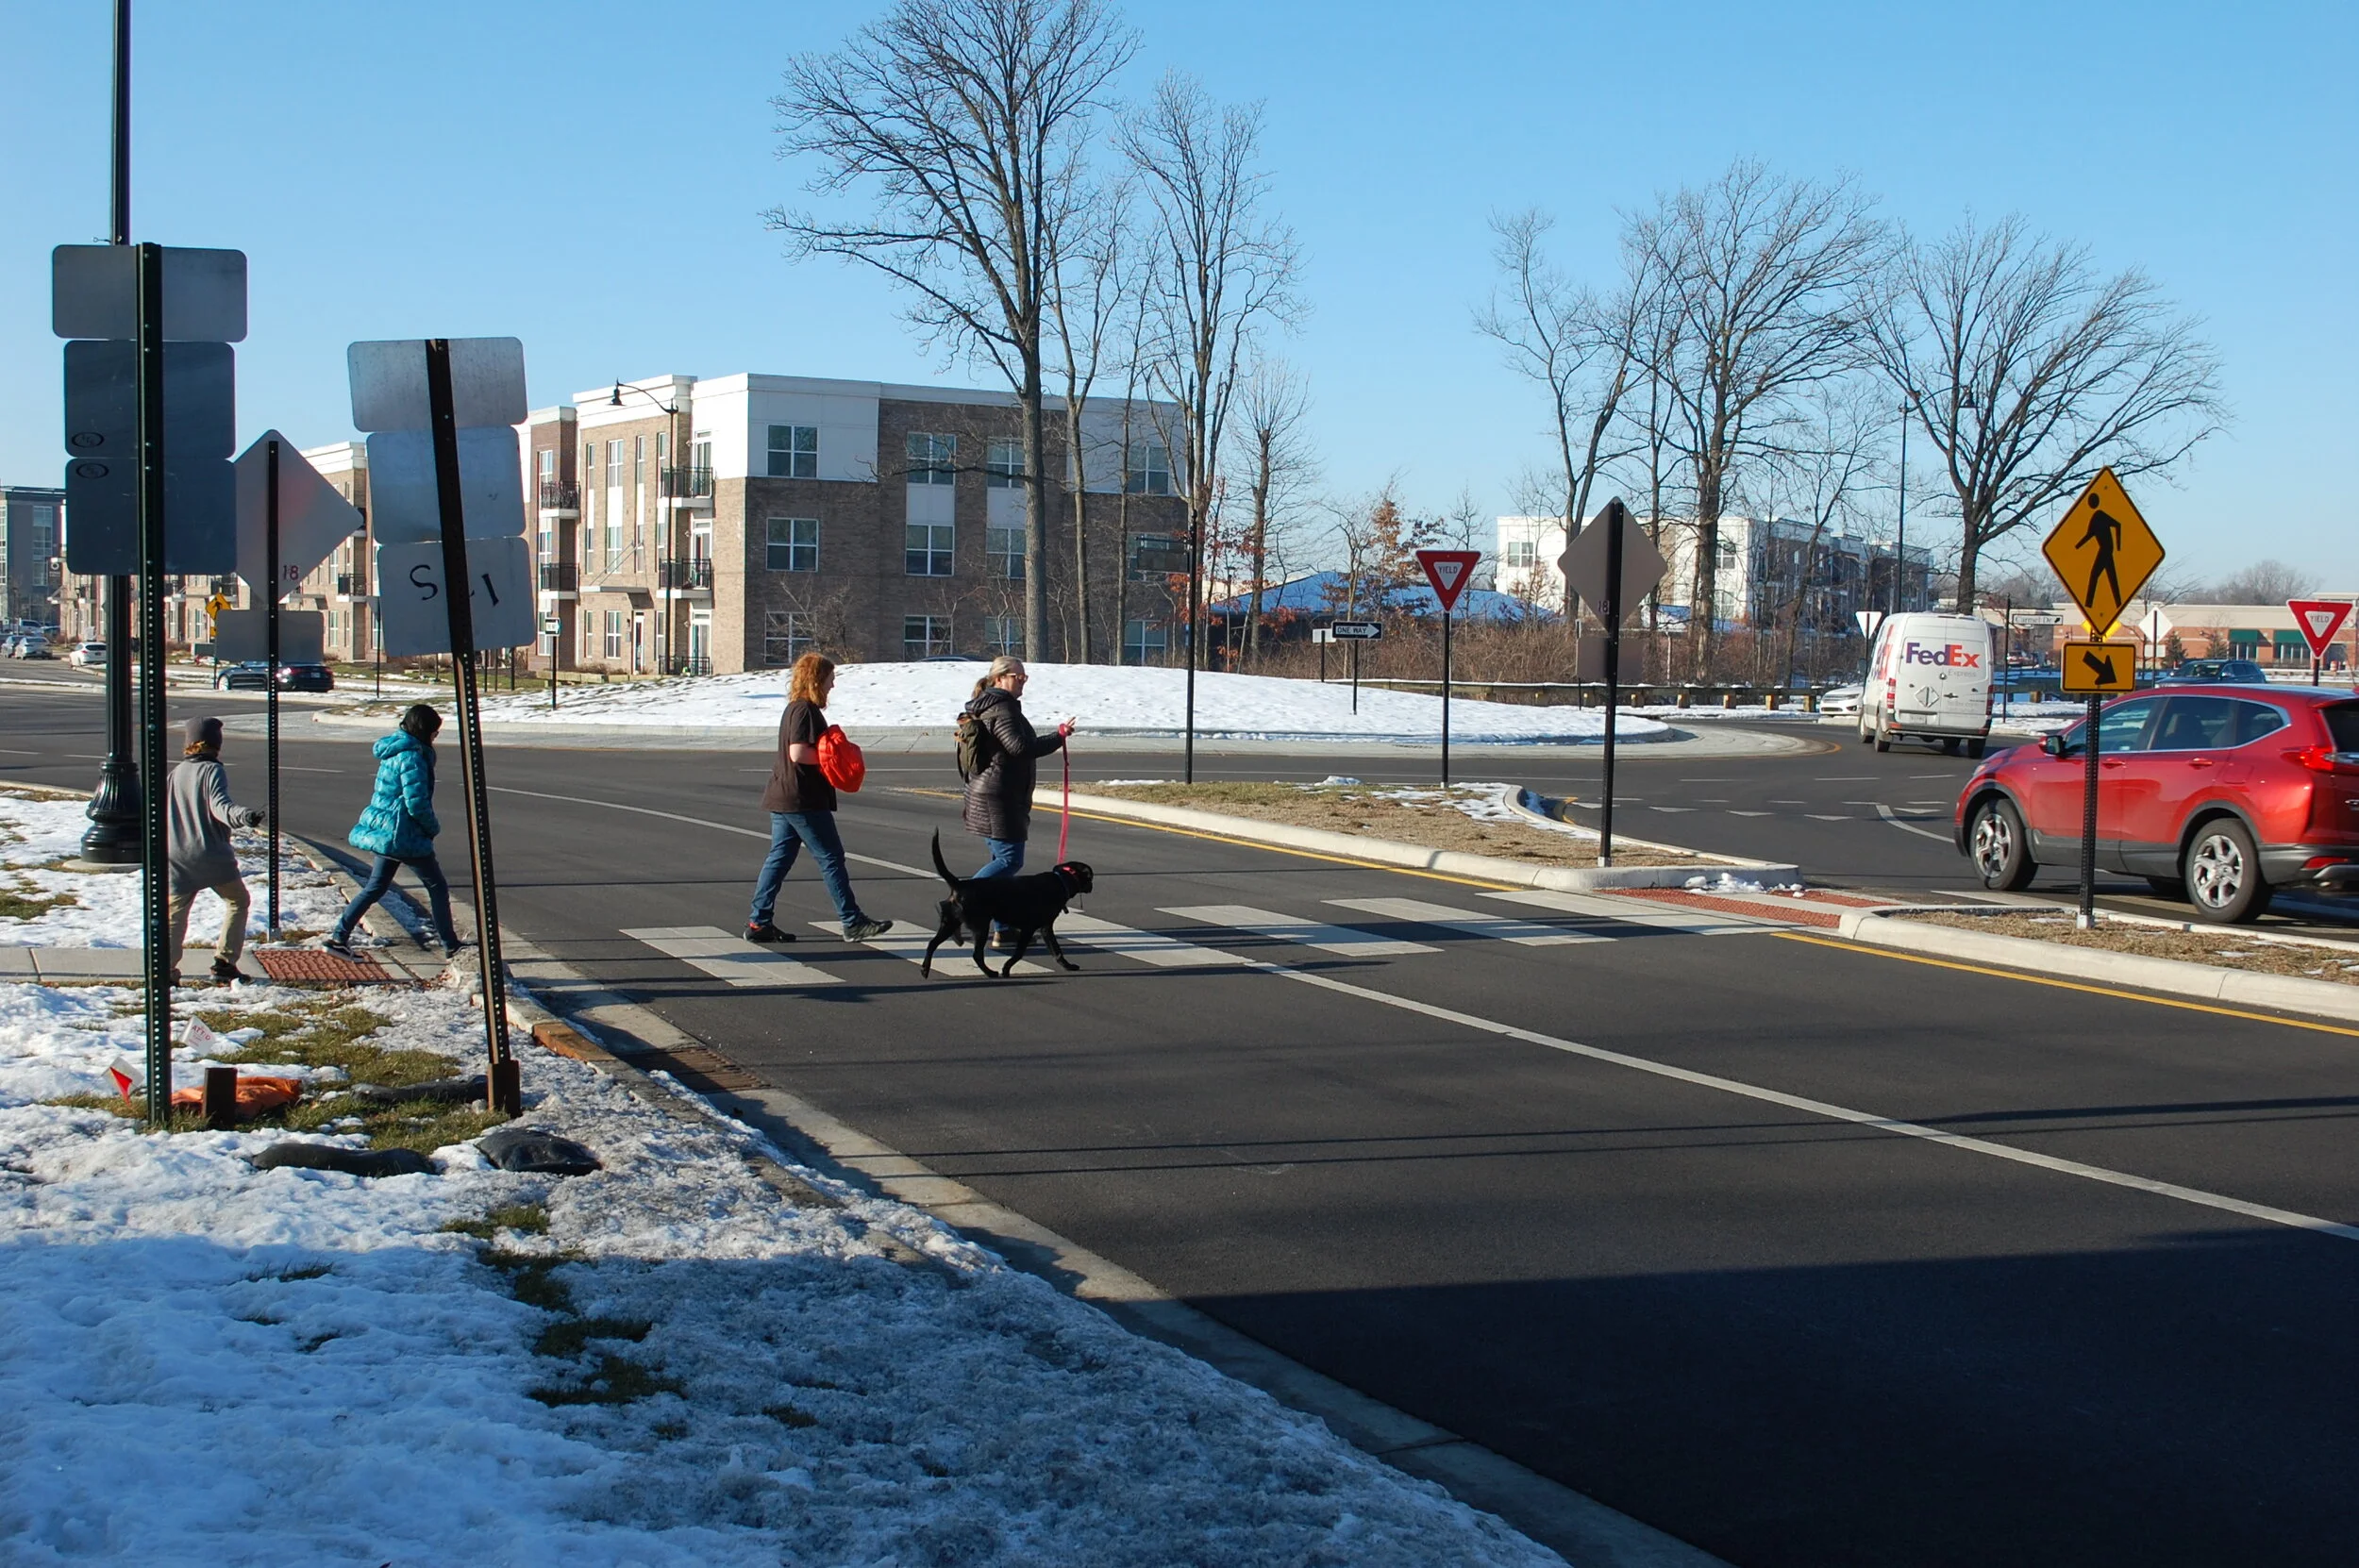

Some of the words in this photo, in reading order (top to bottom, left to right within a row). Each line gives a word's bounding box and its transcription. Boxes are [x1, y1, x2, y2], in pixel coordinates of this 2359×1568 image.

[283, 565, 299, 580] 18
[1598, 600, 1609, 613] 18
[1906, 642, 1980, 668] FedEx
